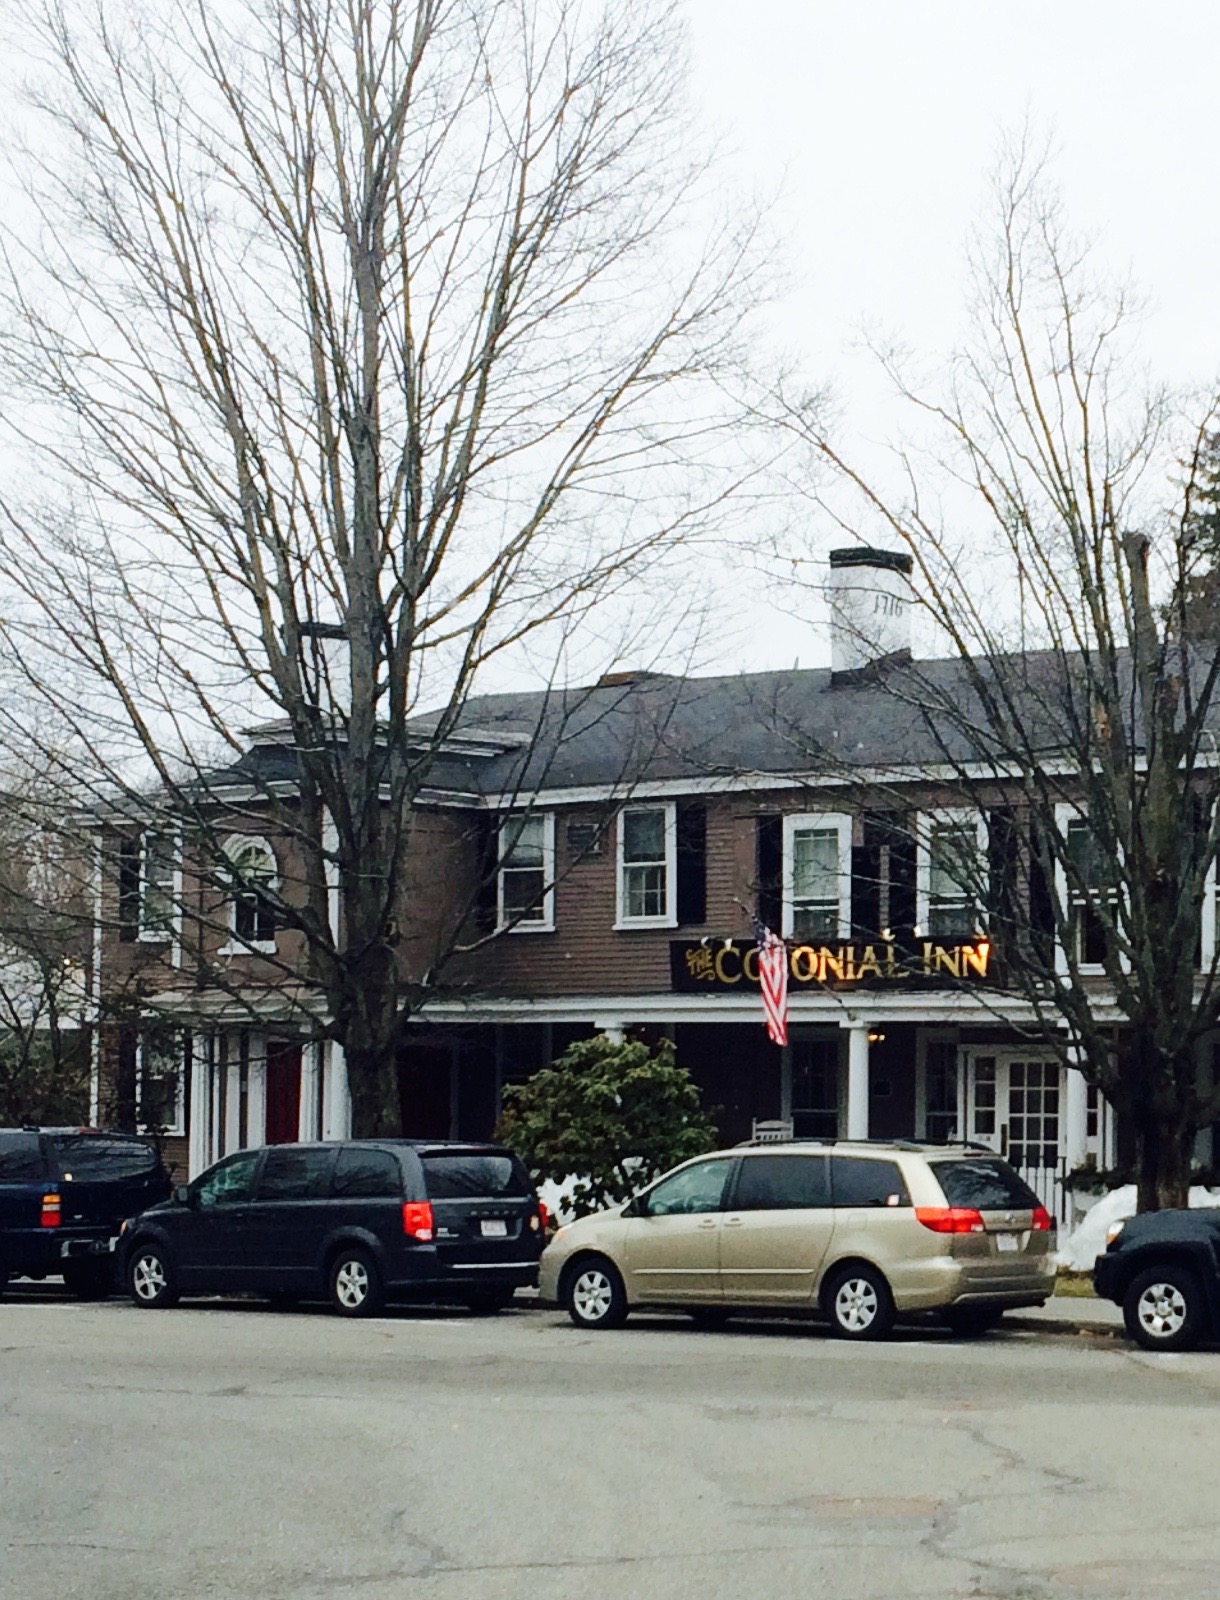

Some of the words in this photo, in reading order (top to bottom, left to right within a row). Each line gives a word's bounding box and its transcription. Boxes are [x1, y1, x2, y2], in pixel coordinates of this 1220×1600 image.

[686, 948, 715, 981] THE
[715, 942, 910, 984] COONIAL
[924, 942, 990, 978] INN
